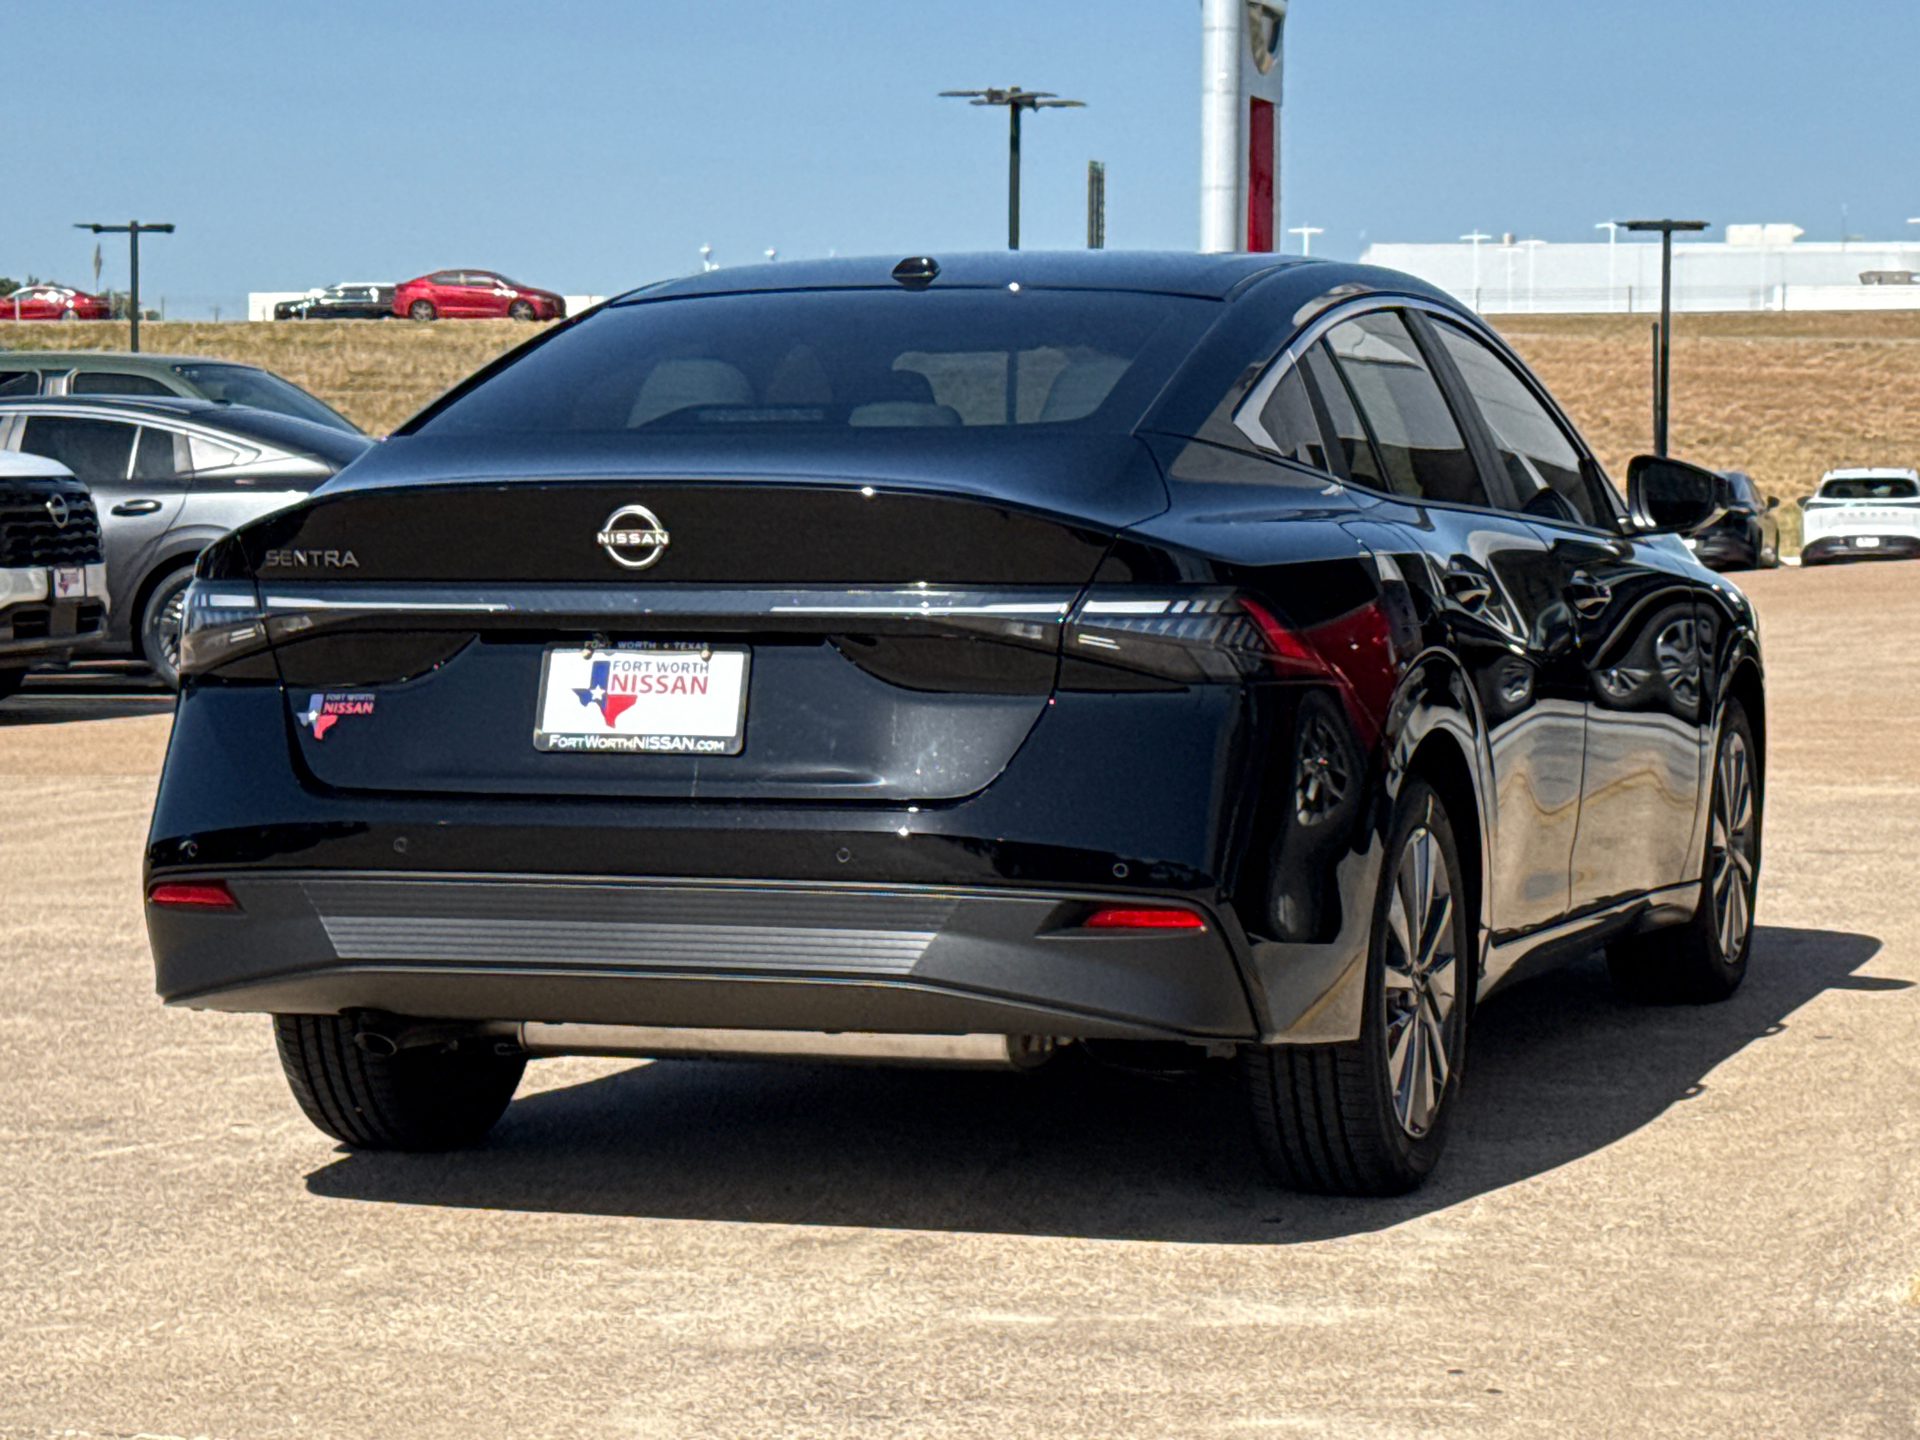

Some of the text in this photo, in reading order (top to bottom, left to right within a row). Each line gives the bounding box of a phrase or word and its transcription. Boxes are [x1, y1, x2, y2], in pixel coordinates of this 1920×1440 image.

[597, 532, 669, 545] NISSAN
[265, 549, 360, 568] SENTRA
[617, 641, 657, 649] WORTH
[674, 642, 709, 651] TEXAS
[613, 661, 709, 674] FORT WORTH
[611, 674, 709, 695] NISSAN
[323, 702, 374, 714] NISSAN
